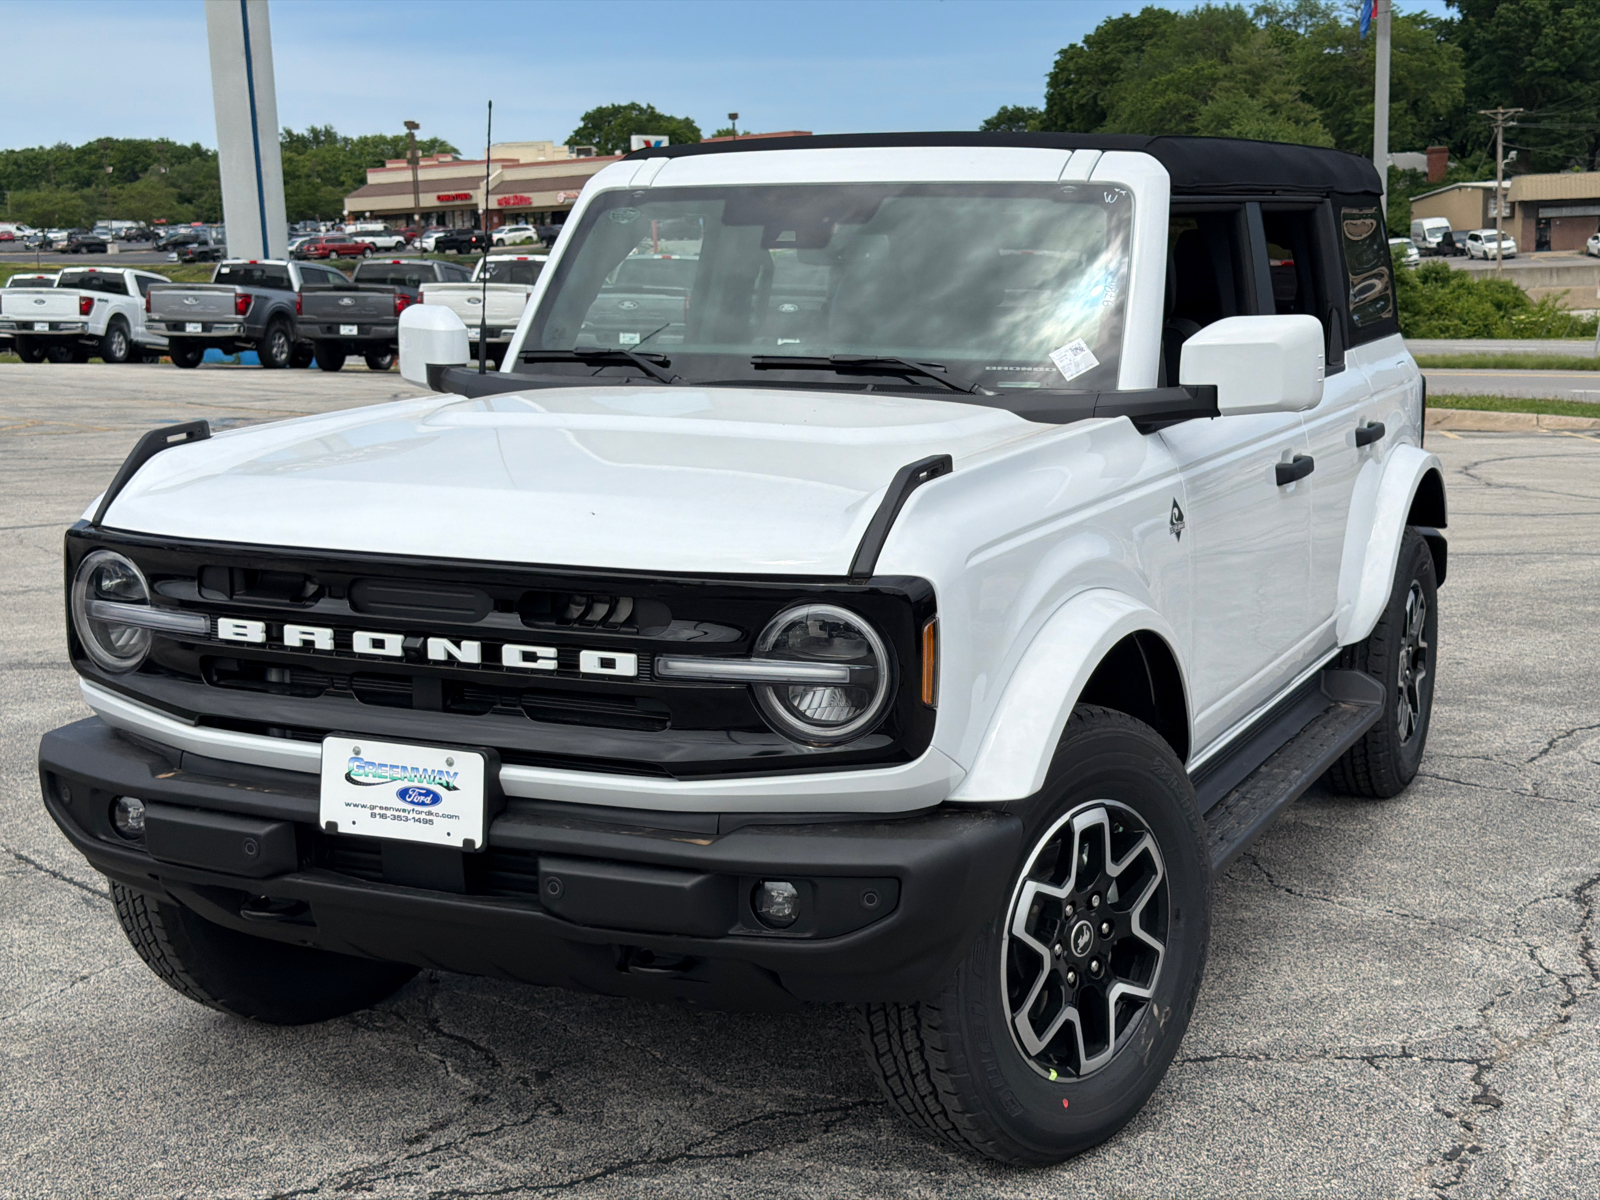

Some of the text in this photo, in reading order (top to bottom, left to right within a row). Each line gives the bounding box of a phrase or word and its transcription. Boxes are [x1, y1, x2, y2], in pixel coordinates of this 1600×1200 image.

[217, 617, 638, 677] BRONCO
[348, 756, 459, 788] GREENWAY
[405, 787, 433, 805] Ford
[344, 801, 460, 821] www.greenwayfordkc.com
[370, 812, 434, 826] 816-353-1495
